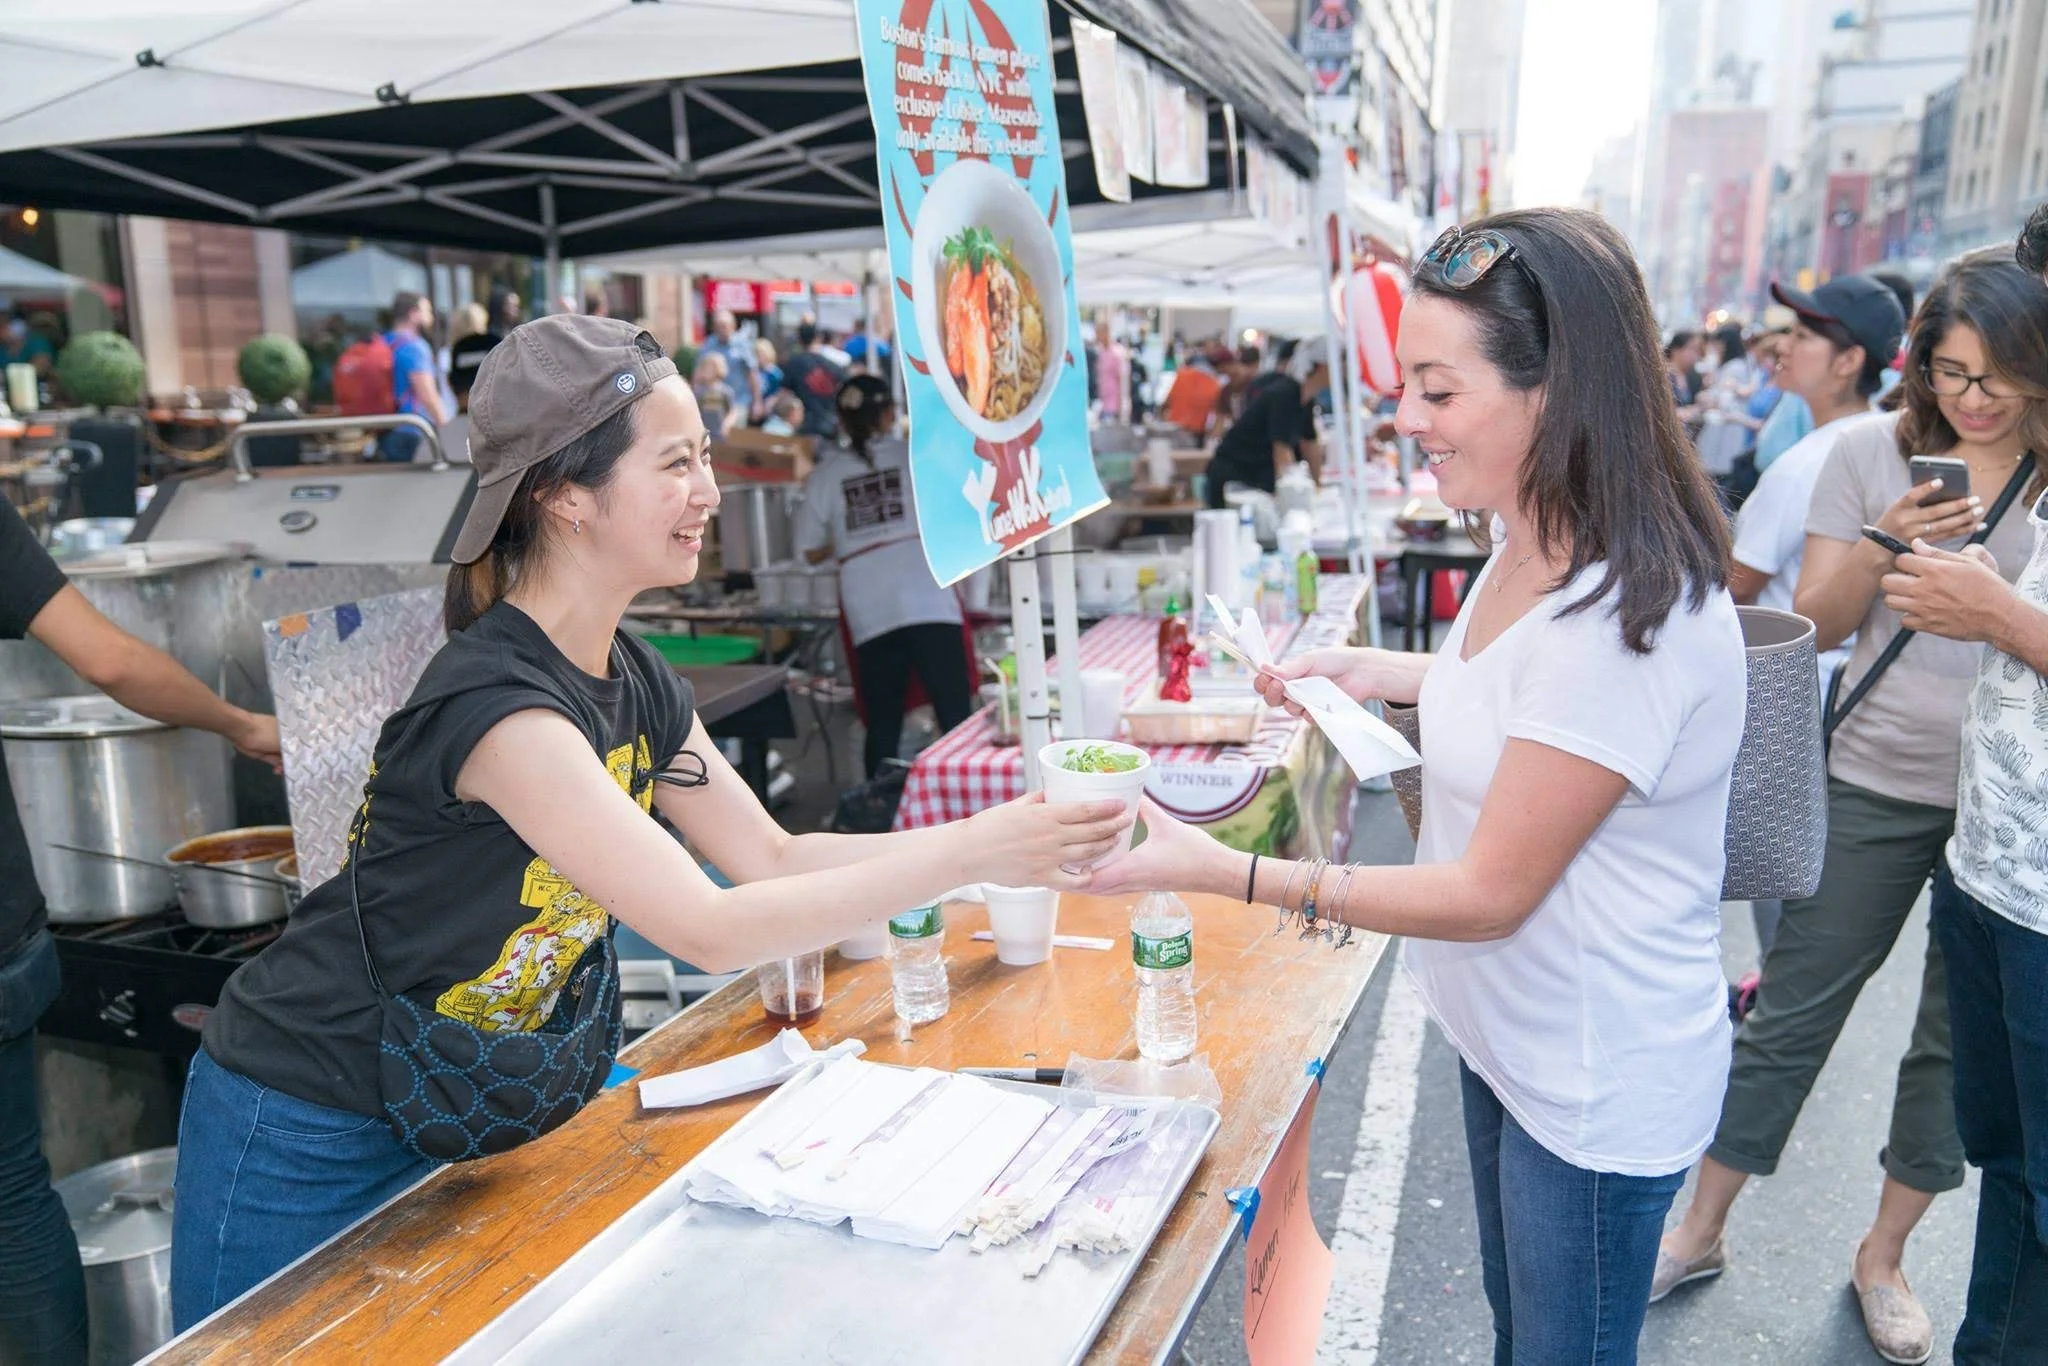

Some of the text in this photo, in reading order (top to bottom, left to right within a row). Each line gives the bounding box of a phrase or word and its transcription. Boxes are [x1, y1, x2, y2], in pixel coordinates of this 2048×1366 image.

[880, 16, 925, 52] Boston's
[971, 45, 1008, 66] ramen
[1009, 45, 1040, 74] place
[897, 61, 932, 85] comes
[934, 62, 962, 89] back
[976, 69, 1005, 95] NYC
[1006, 72, 1032, 98] with
[895, 88, 943, 119] exclusive
[896, 121, 921, 157] only
[1160, 772, 1232, 787] WINNER
[1159, 945, 1189, 962] Spring
[1161, 938, 1186, 951] Poland
